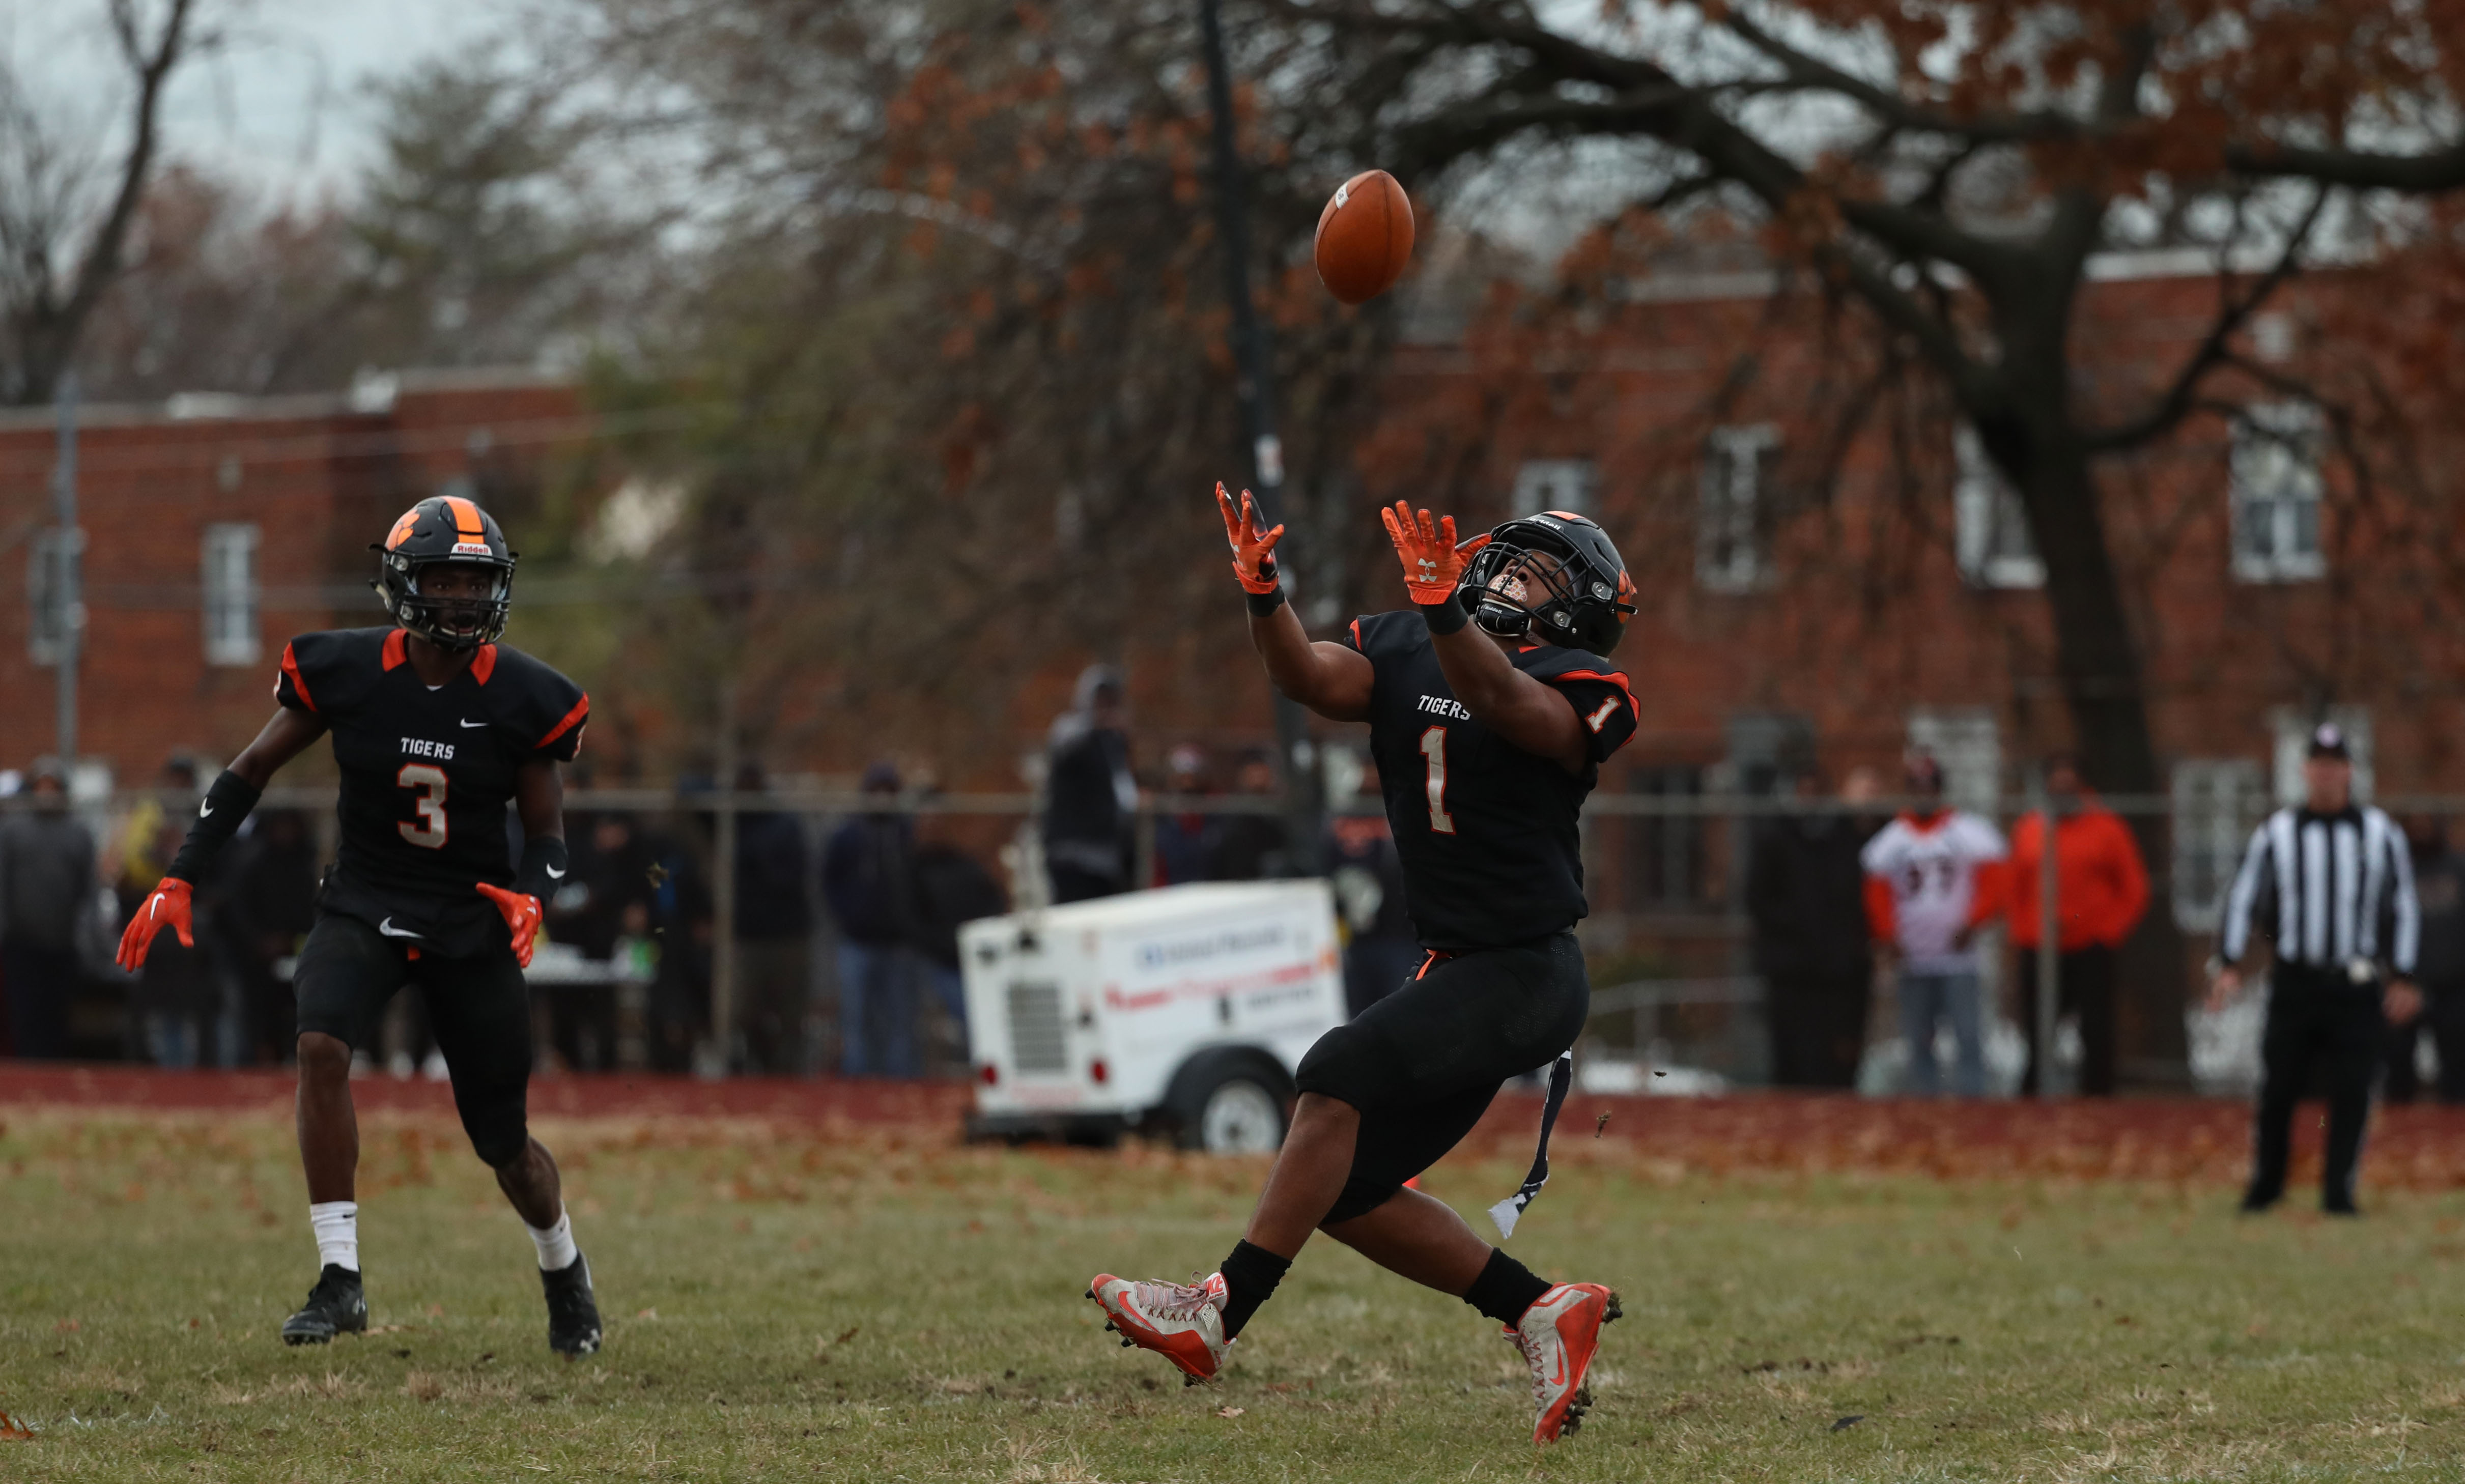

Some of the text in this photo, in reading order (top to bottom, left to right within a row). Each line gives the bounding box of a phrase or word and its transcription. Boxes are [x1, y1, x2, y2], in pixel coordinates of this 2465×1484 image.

[458, 545, 488, 554] Riddell
[1584, 695, 1621, 734] 1
[401, 737, 455, 759] TIGERS
[1420, 725, 1456, 835] 1
[397, 762, 449, 849] 3
